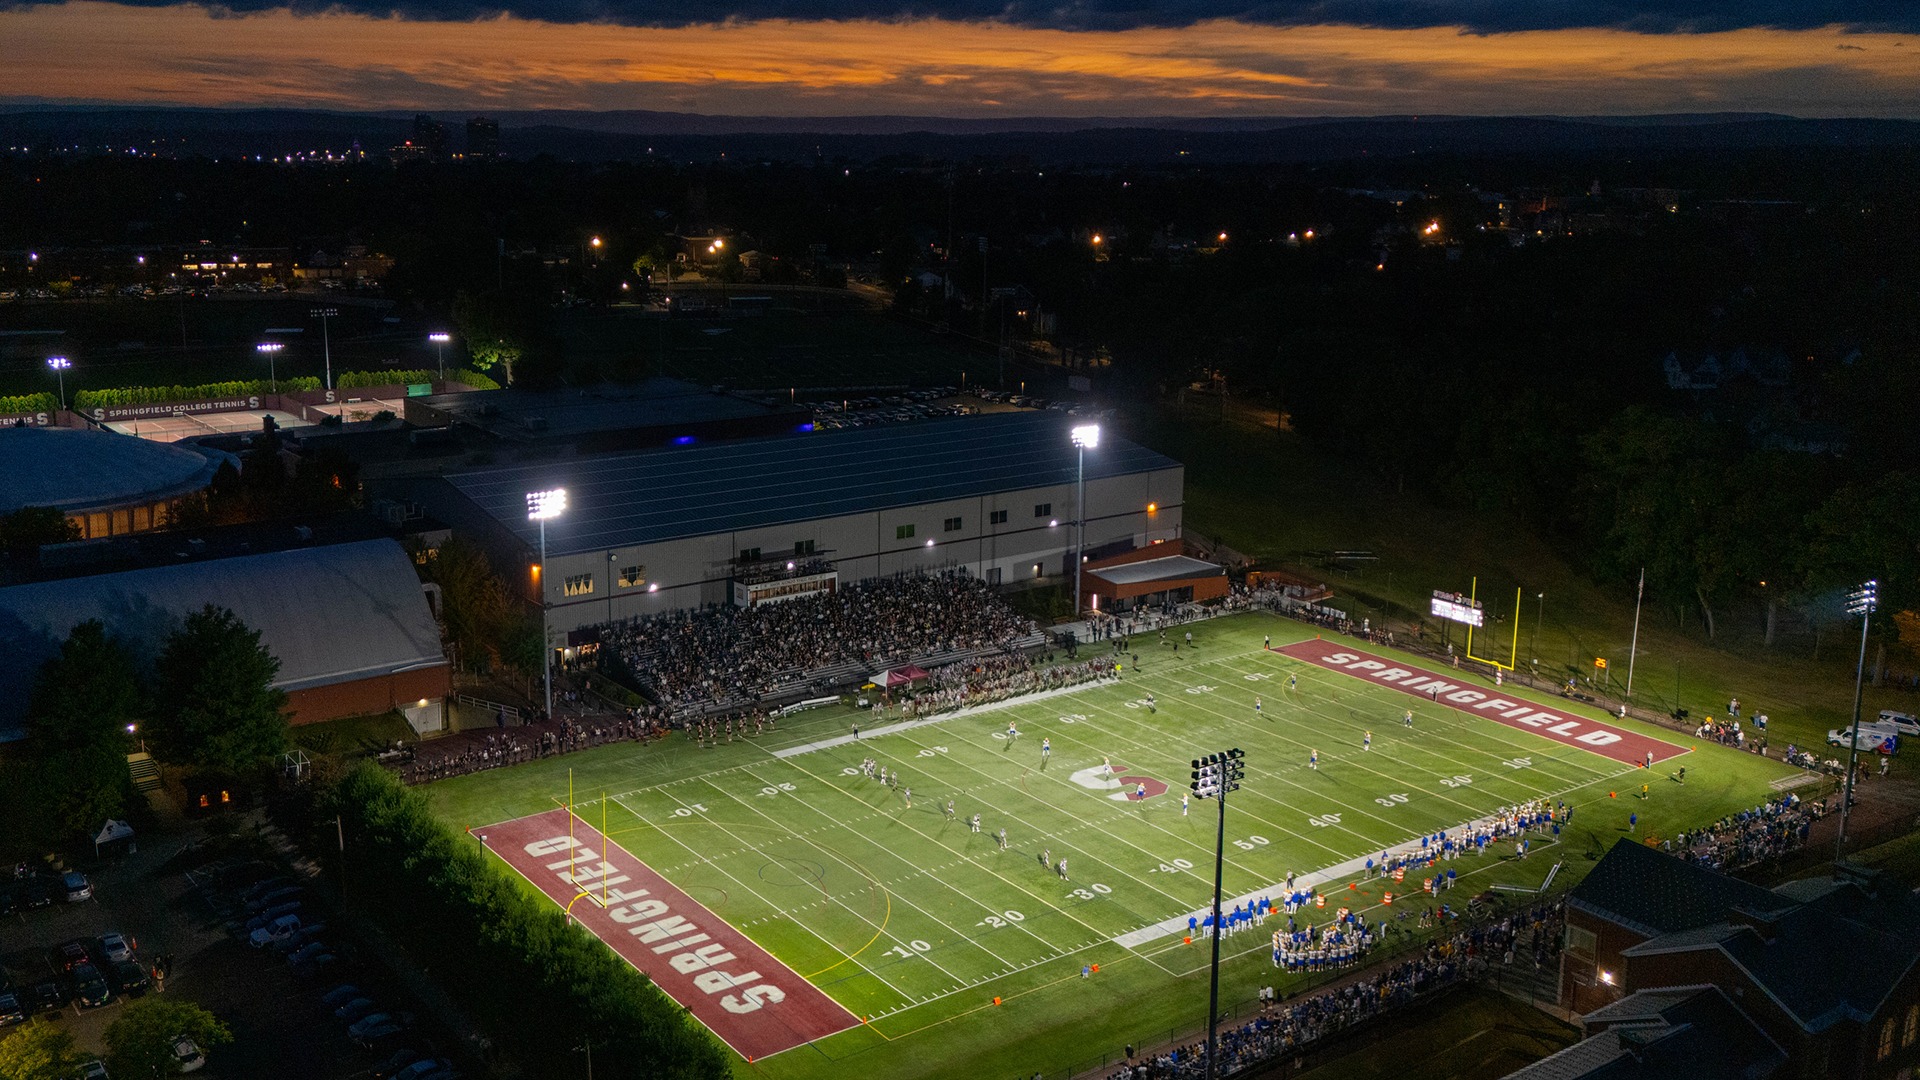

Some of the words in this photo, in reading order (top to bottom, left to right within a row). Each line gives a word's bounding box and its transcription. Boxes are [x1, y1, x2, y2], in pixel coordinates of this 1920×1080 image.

[325, 391, 335, 402] S
[109, 407, 171, 417] SPRINGFIELD
[173, 403, 212, 412] COLLEGE
[213, 400, 246, 409] TENNIS
[249, 396, 259, 409] S
[36, 412, 48, 425] S
[1595, 657, 1606, 668] 25
[1243, 672, 1269, 682] 10
[1185, 685, 1213, 695] 20
[1321, 652, 1622, 746] SPRINGFIELD
[1059, 713, 1087, 724] 40
[919, 745, 949, 757] 40
[1503, 757, 1531, 770] 10
[762, 782, 797, 795] 20
[1439, 775, 1472, 789] 20
[1375, 793, 1409, 807] 30
[674, 803, 708, 817] 10
[1308, 814, 1341, 828] 40
[1232, 835, 1270, 850] 50
[1159, 857, 1193, 874] 40
[1073, 883, 1112, 901] 30
[524, 835, 786, 1014] SPRINGFIELD
[984, 910, 1025, 928] 20
[892, 939, 931, 959] 10
